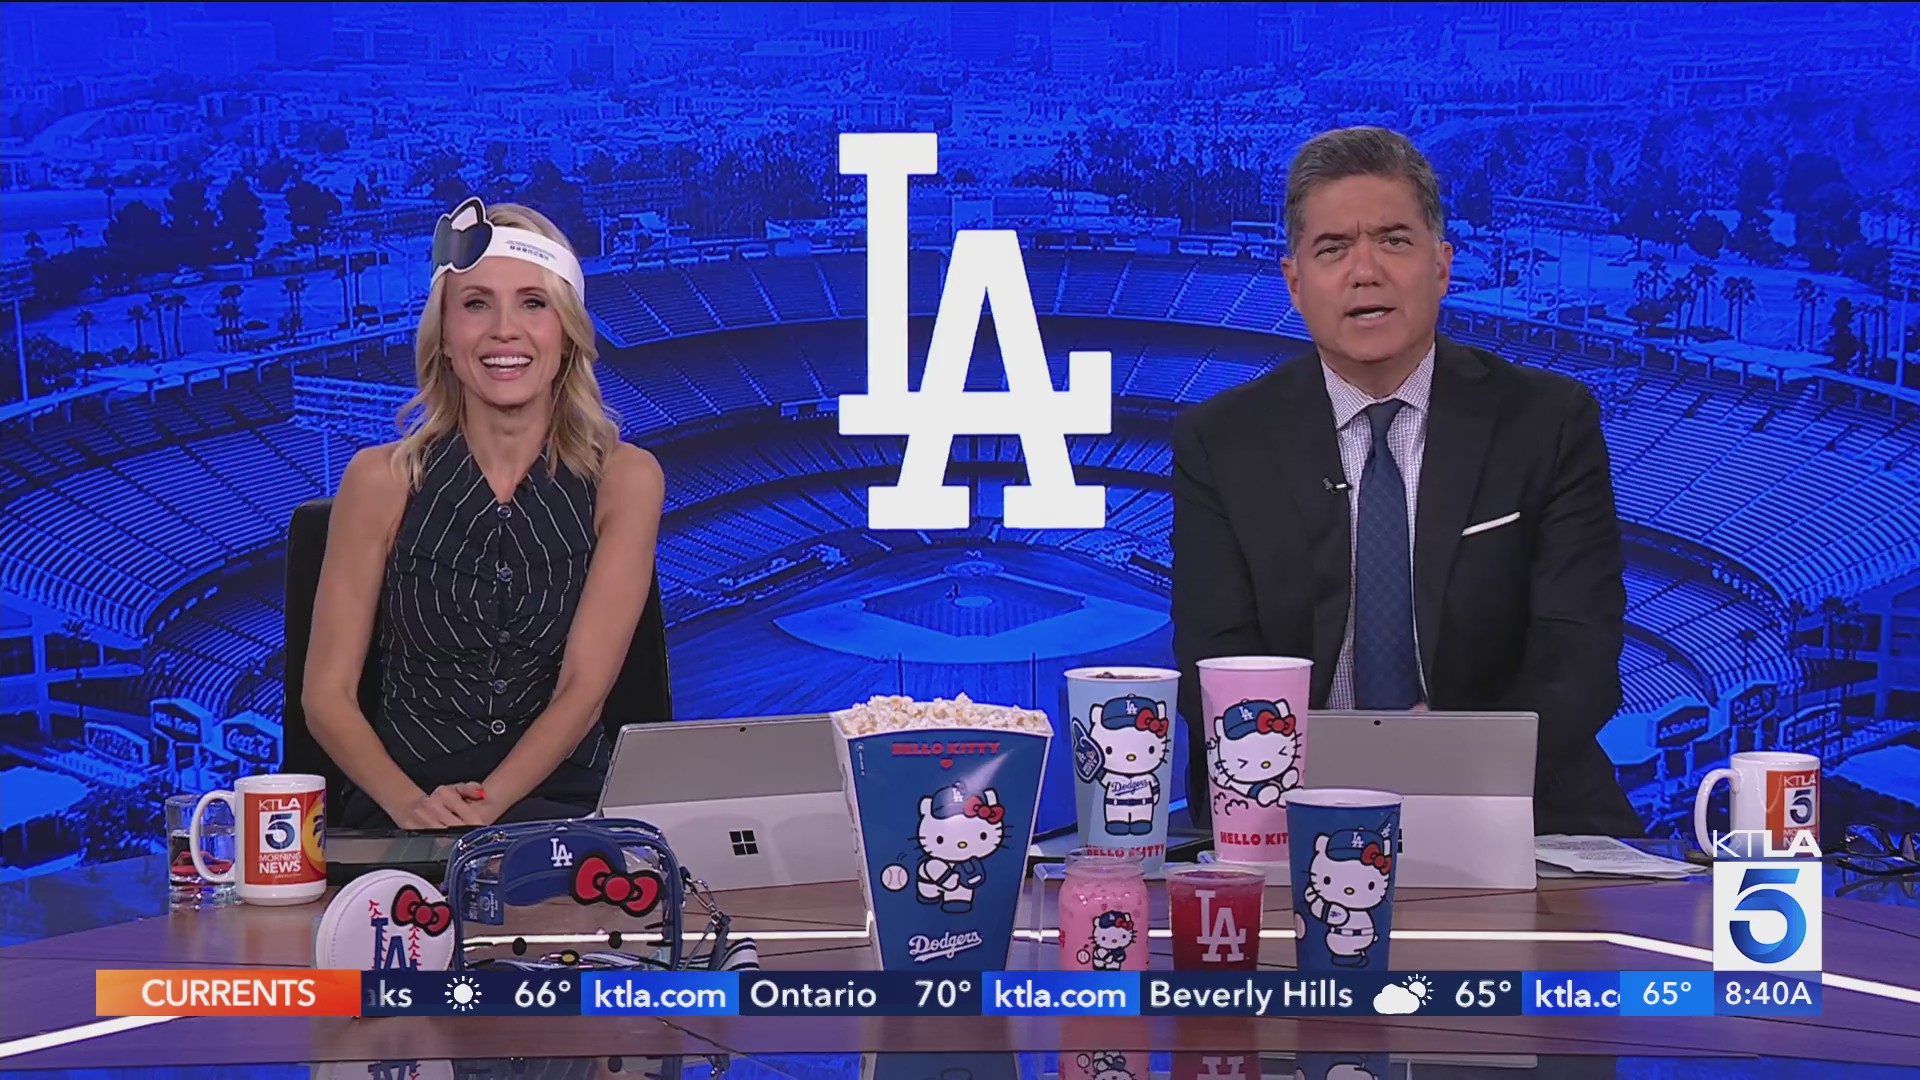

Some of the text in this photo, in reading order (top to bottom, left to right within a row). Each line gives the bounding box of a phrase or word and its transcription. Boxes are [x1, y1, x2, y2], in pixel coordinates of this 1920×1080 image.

[840, 134, 1112, 529] LA
[1125, 700, 1138, 715] LA
[1239, 706, 1254, 721] LA
[892, 742, 1000, 755] HELLO KITTY
[1111, 779, 1149, 796] Dodgers
[1784, 774, 1817, 787] KTLA
[259, 798, 301, 810] KTLA
[1790, 789, 1813, 824] 5
[265, 813, 295, 850] 5
[1220, 832, 1262, 846] HELLO
[1351, 832, 1364, 848] LA
[259, 852, 302, 862] MORNING
[550, 838, 573, 867] LA
[259, 861, 302, 874] NEWS
[1195, 890, 1247, 963] LA
[908, 931, 982, 962] Dodgers
